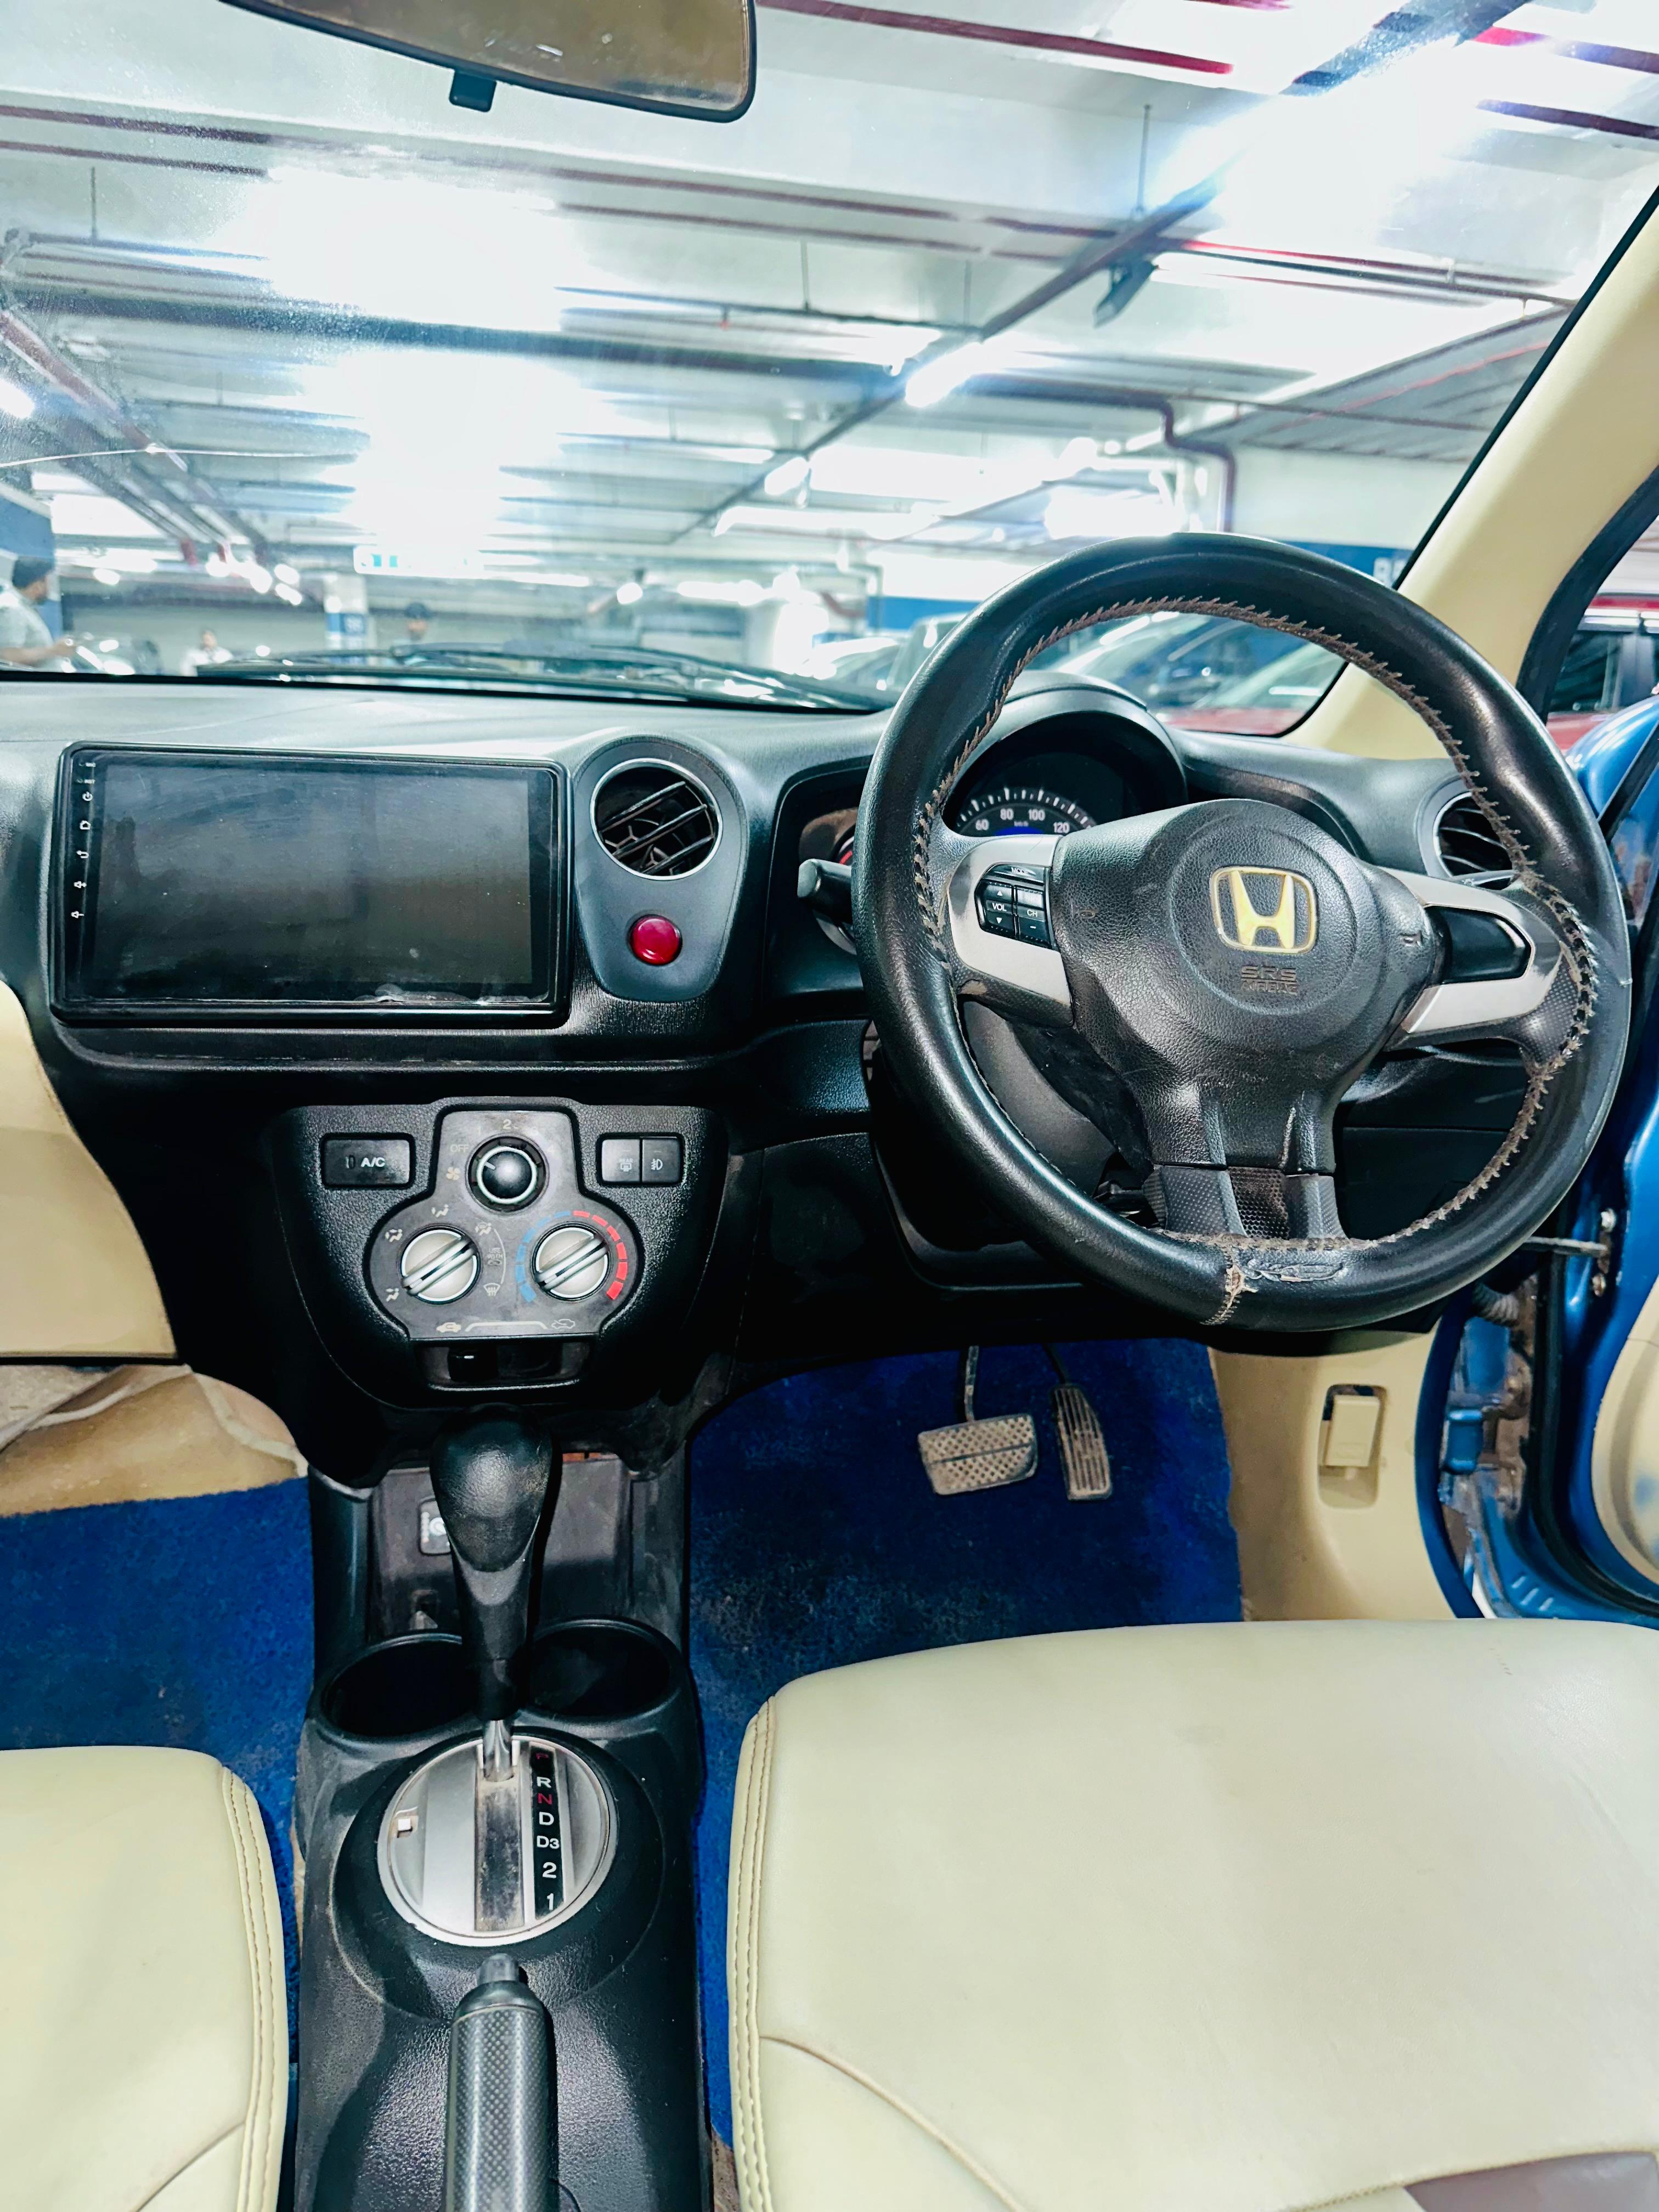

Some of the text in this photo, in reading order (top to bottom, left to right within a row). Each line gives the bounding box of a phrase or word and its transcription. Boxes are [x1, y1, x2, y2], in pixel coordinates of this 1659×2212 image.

[1000, 808, 1014, 820] 80
[1029, 809, 1045, 821] 100
[975, 819, 989, 831] 60
[1053, 822, 1070, 833] 120
[992, 902, 1007, 912] VOL
[1026, 909, 1038, 917] CH
[1242, 965, 1297, 982] SRS
[503, 1119, 512, 1130] 2
[450, 1144, 469, 1153] OFF
[360, 1157, 386, 1167] A/C
[537, 1776, 552, 1788] R
[538, 1793, 552, 1805] N
[539, 1812, 554, 1826] D
[537, 1835, 560, 1849] D3
[542, 1861, 557, 1878] 2
[546, 1893, 554, 1911] 1
